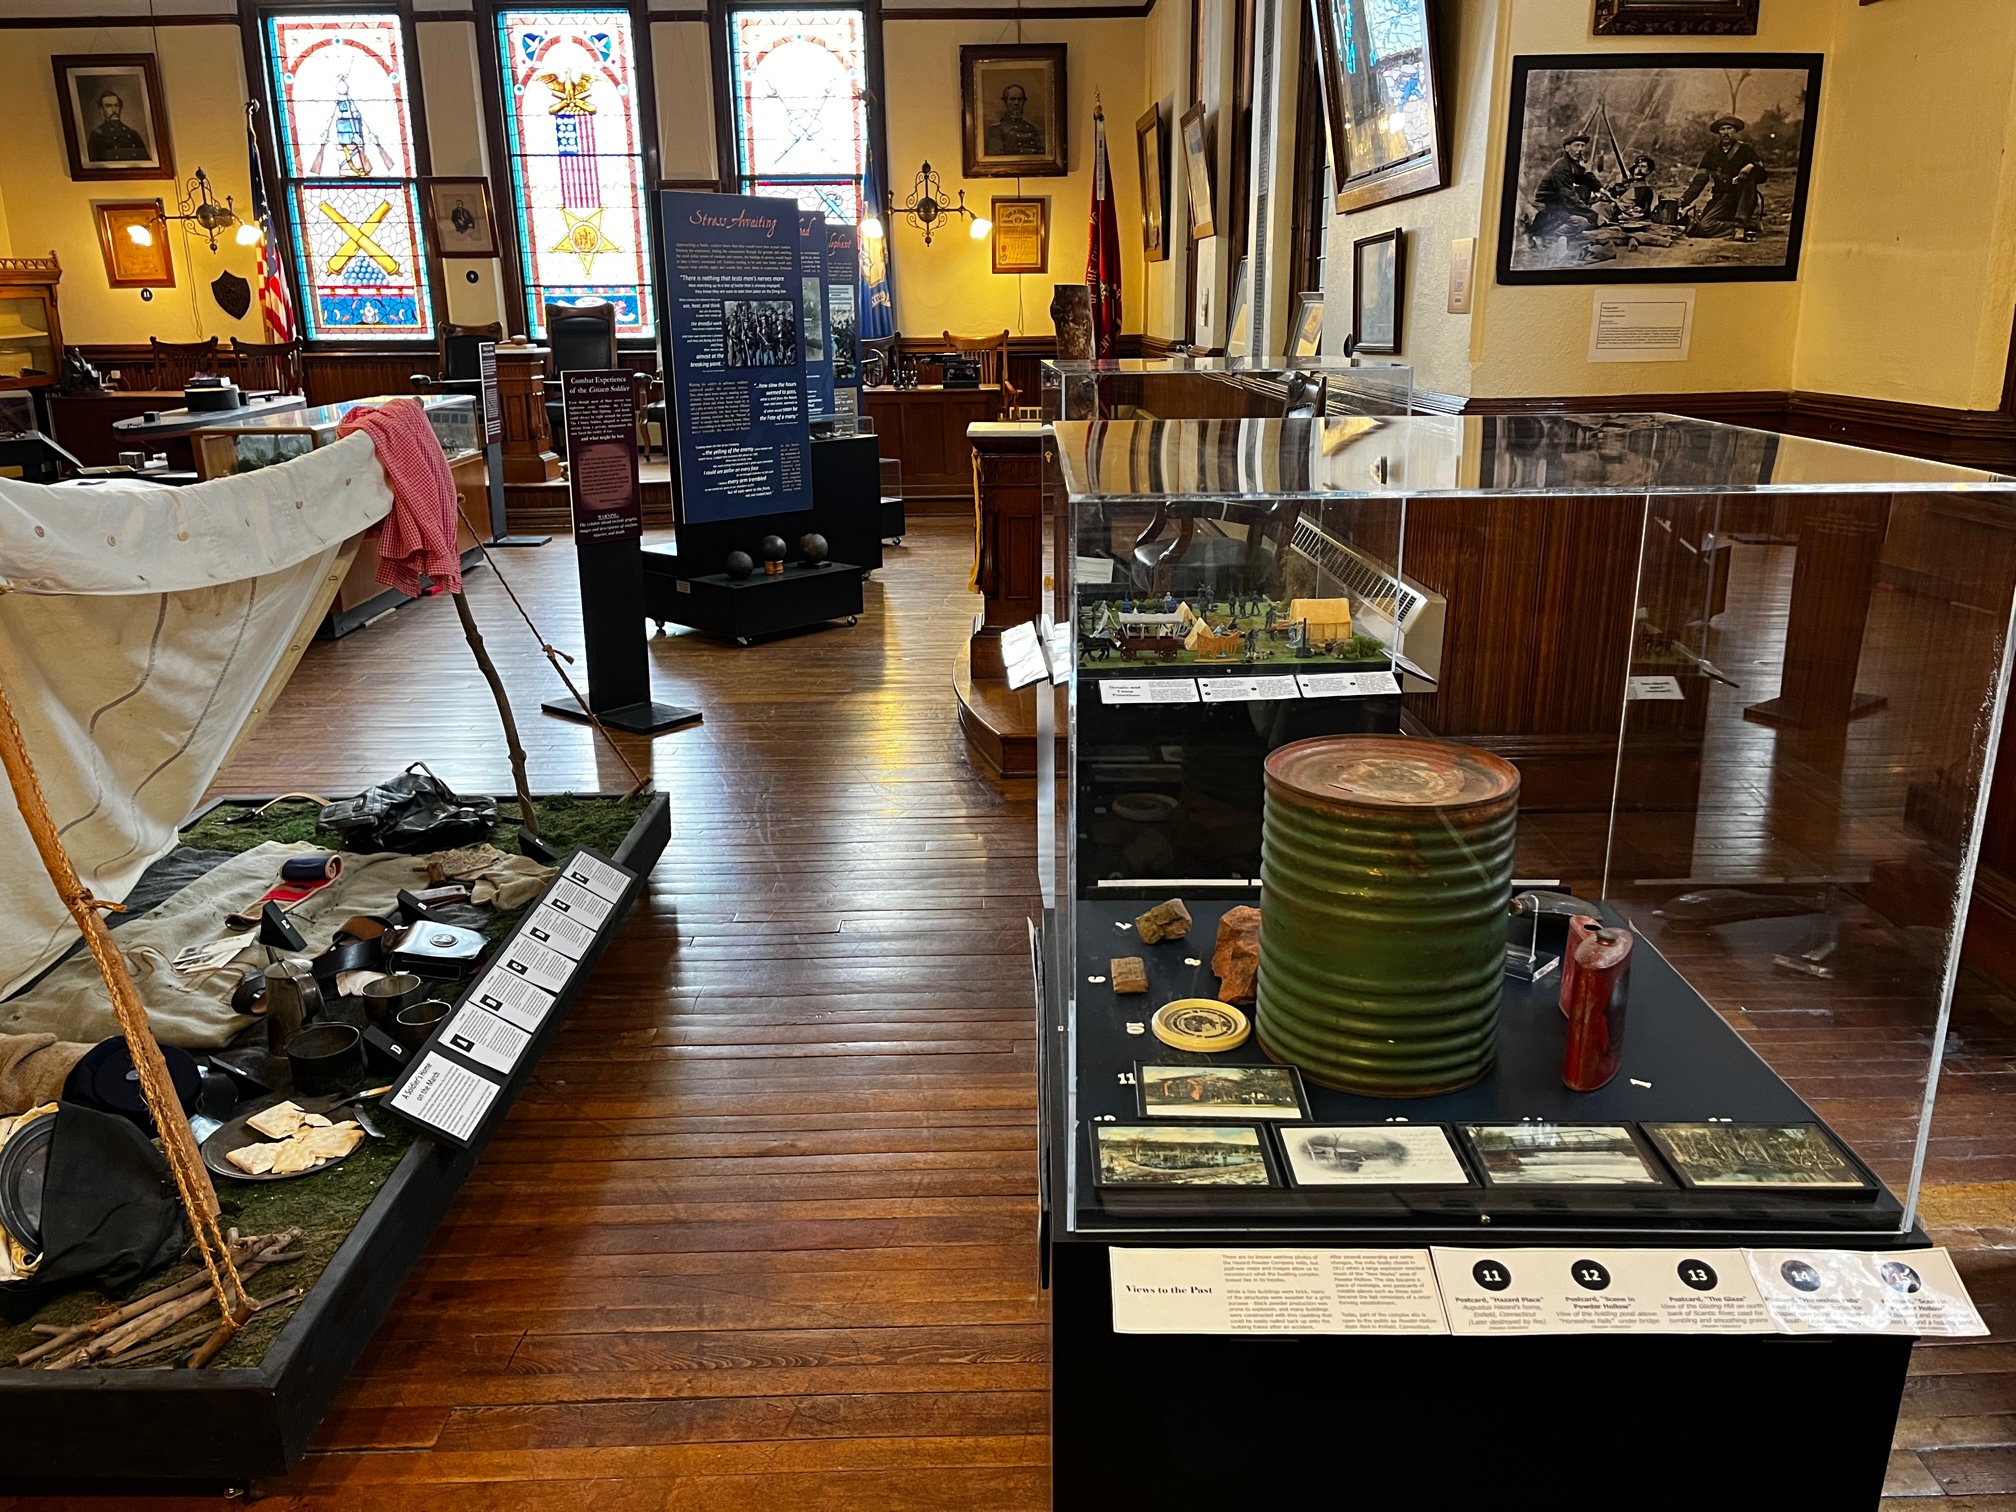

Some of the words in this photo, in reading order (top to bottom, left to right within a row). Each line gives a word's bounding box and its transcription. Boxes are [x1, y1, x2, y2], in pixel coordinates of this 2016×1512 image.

[689, 210, 727, 227] Stress
[726, 208, 777, 238] Awaiting
[486, 999, 497, 1007] B
[457, 1039, 468, 1047] A
[1118, 1073, 1136, 1084] 11
[1482, 1270, 1502, 1281] 11
[1581, 1269, 1601, 1281] 12
[1688, 1269, 1708, 1280] 13
[1791, 1271, 1810, 1282] 14
[1126, 1285, 1155, 1293] Views
